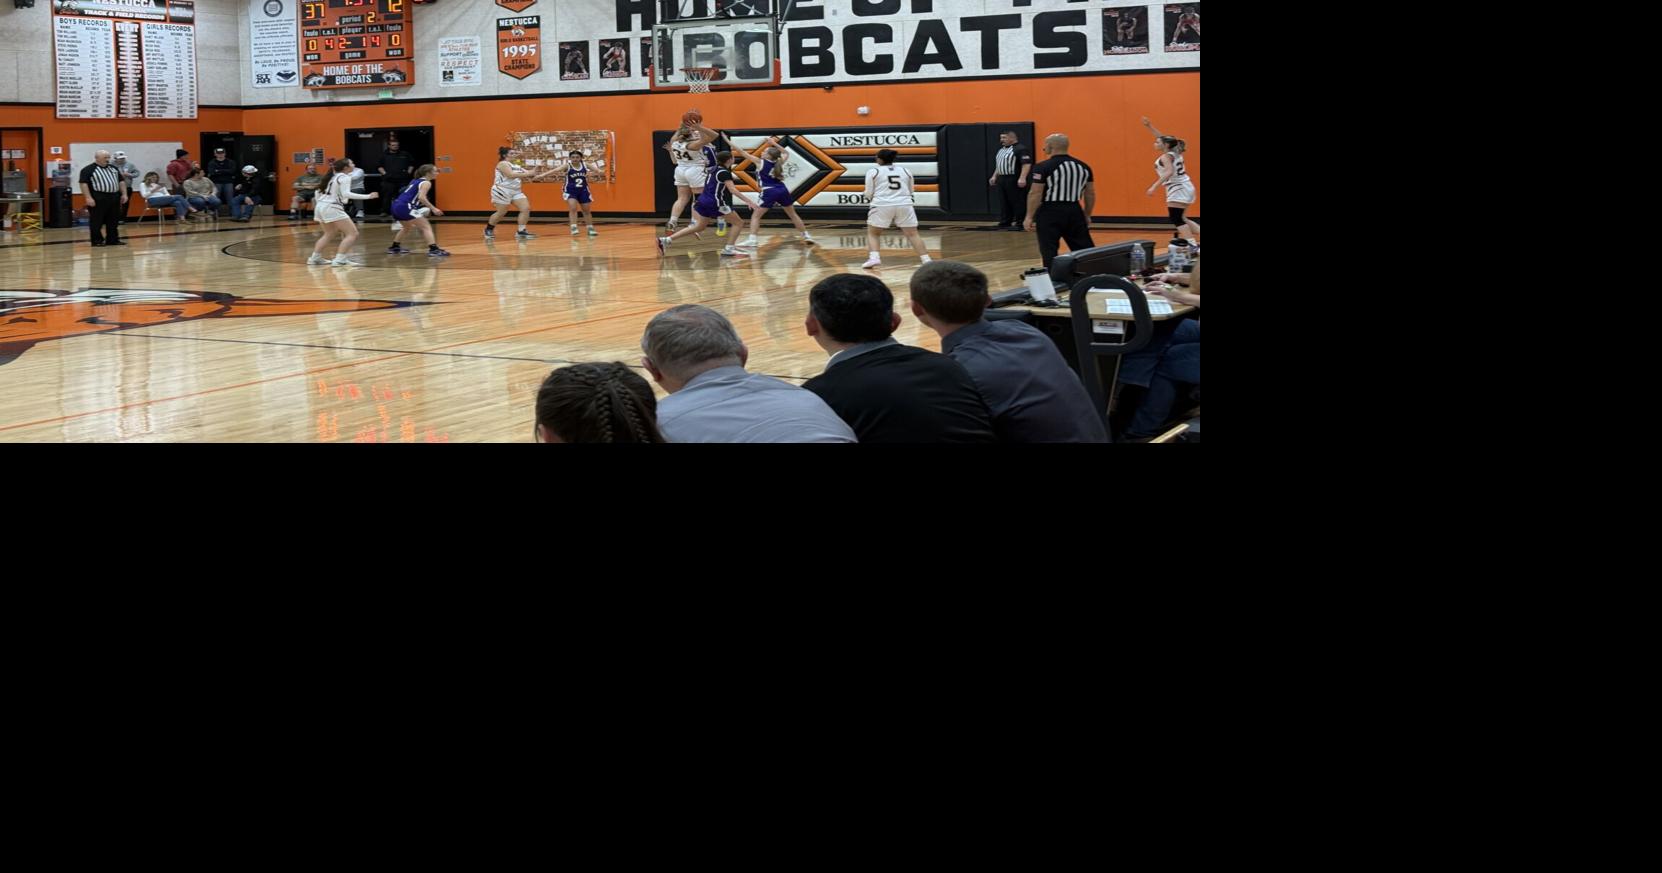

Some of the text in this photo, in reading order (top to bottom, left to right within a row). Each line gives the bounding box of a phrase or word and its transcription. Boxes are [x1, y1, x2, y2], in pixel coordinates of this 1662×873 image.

[306, 4, 324, 19] 37
[367, 12, 375, 22] 2
[499, 17, 537, 26] NESTUCCA
[502, 44, 536, 58] 1995
[323, 64, 383, 76] HOME OF THE
[336, 74, 371, 84] BOBCATS
[830, 135, 920, 146] NESTUCCA
[576, 179, 583, 187] 2
[888, 176, 901, 190] 5
